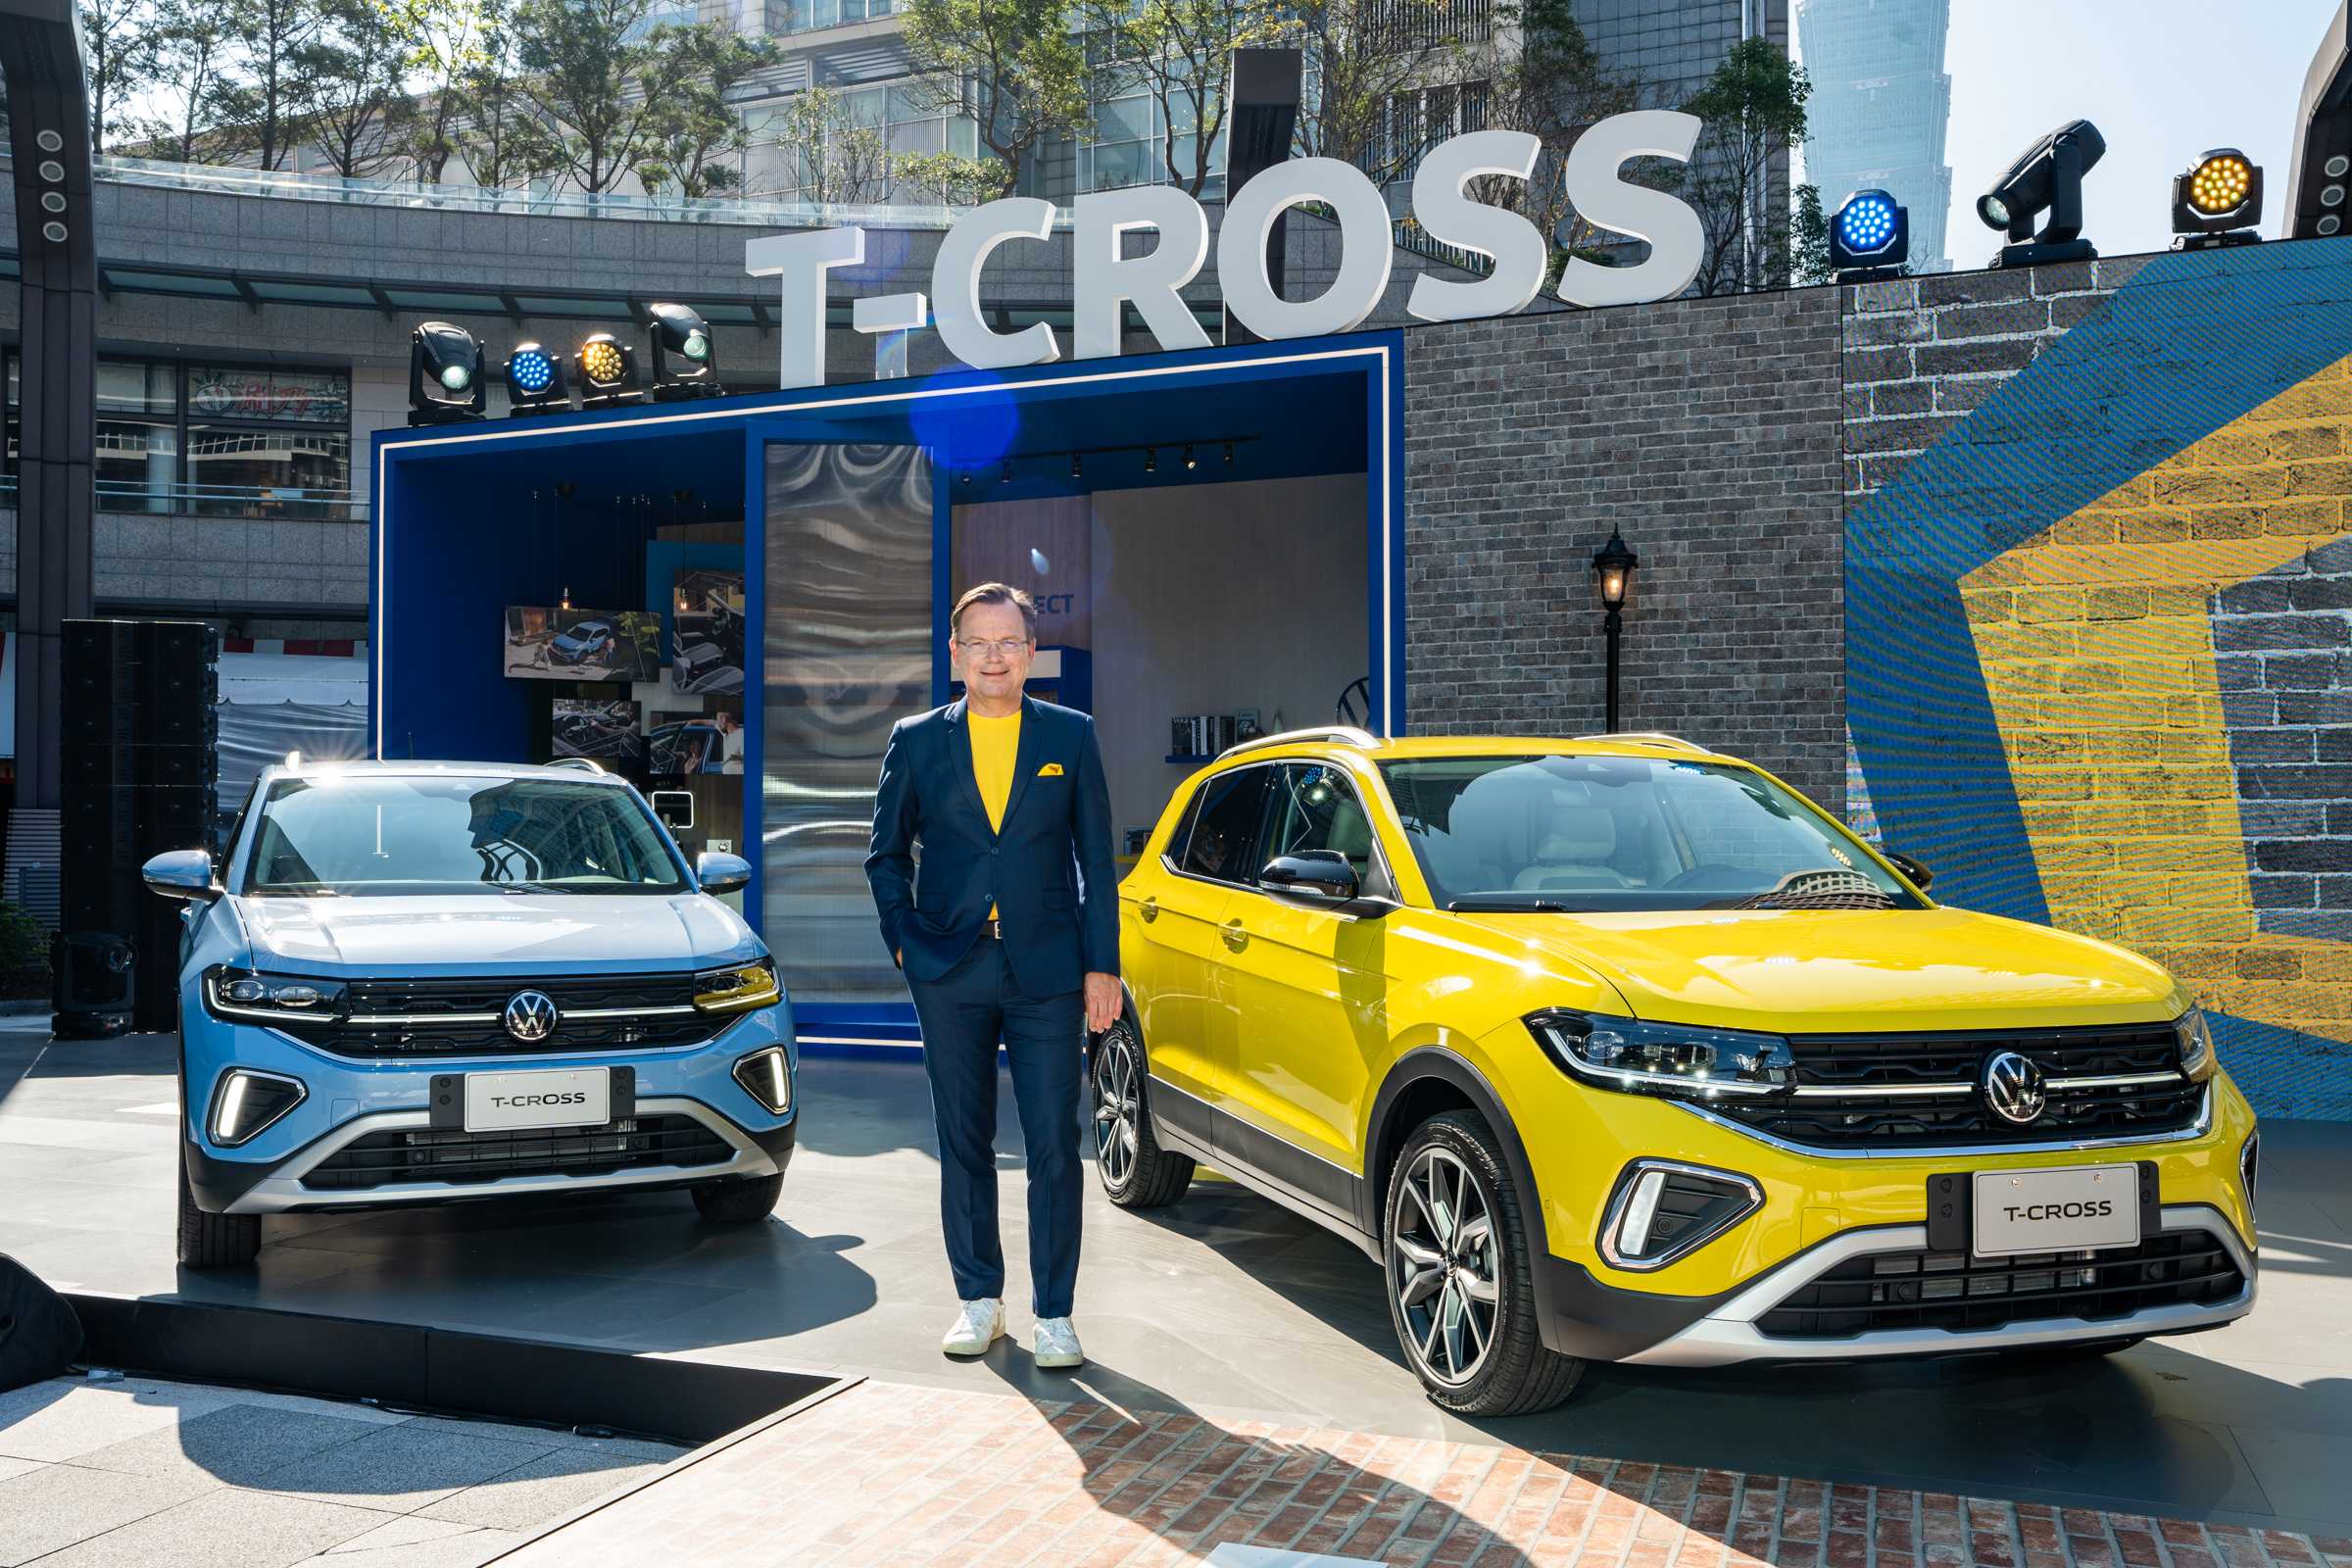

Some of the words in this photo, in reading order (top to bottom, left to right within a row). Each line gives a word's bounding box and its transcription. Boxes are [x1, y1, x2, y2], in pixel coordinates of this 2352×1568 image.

[745, 109, 1703, 390] T-CROSS
[1033, 594, 1075, 614] ECT
[490, 1092, 586, 1108] T-CROSS
[2003, 1200, 2113, 1222] T-CROSS
